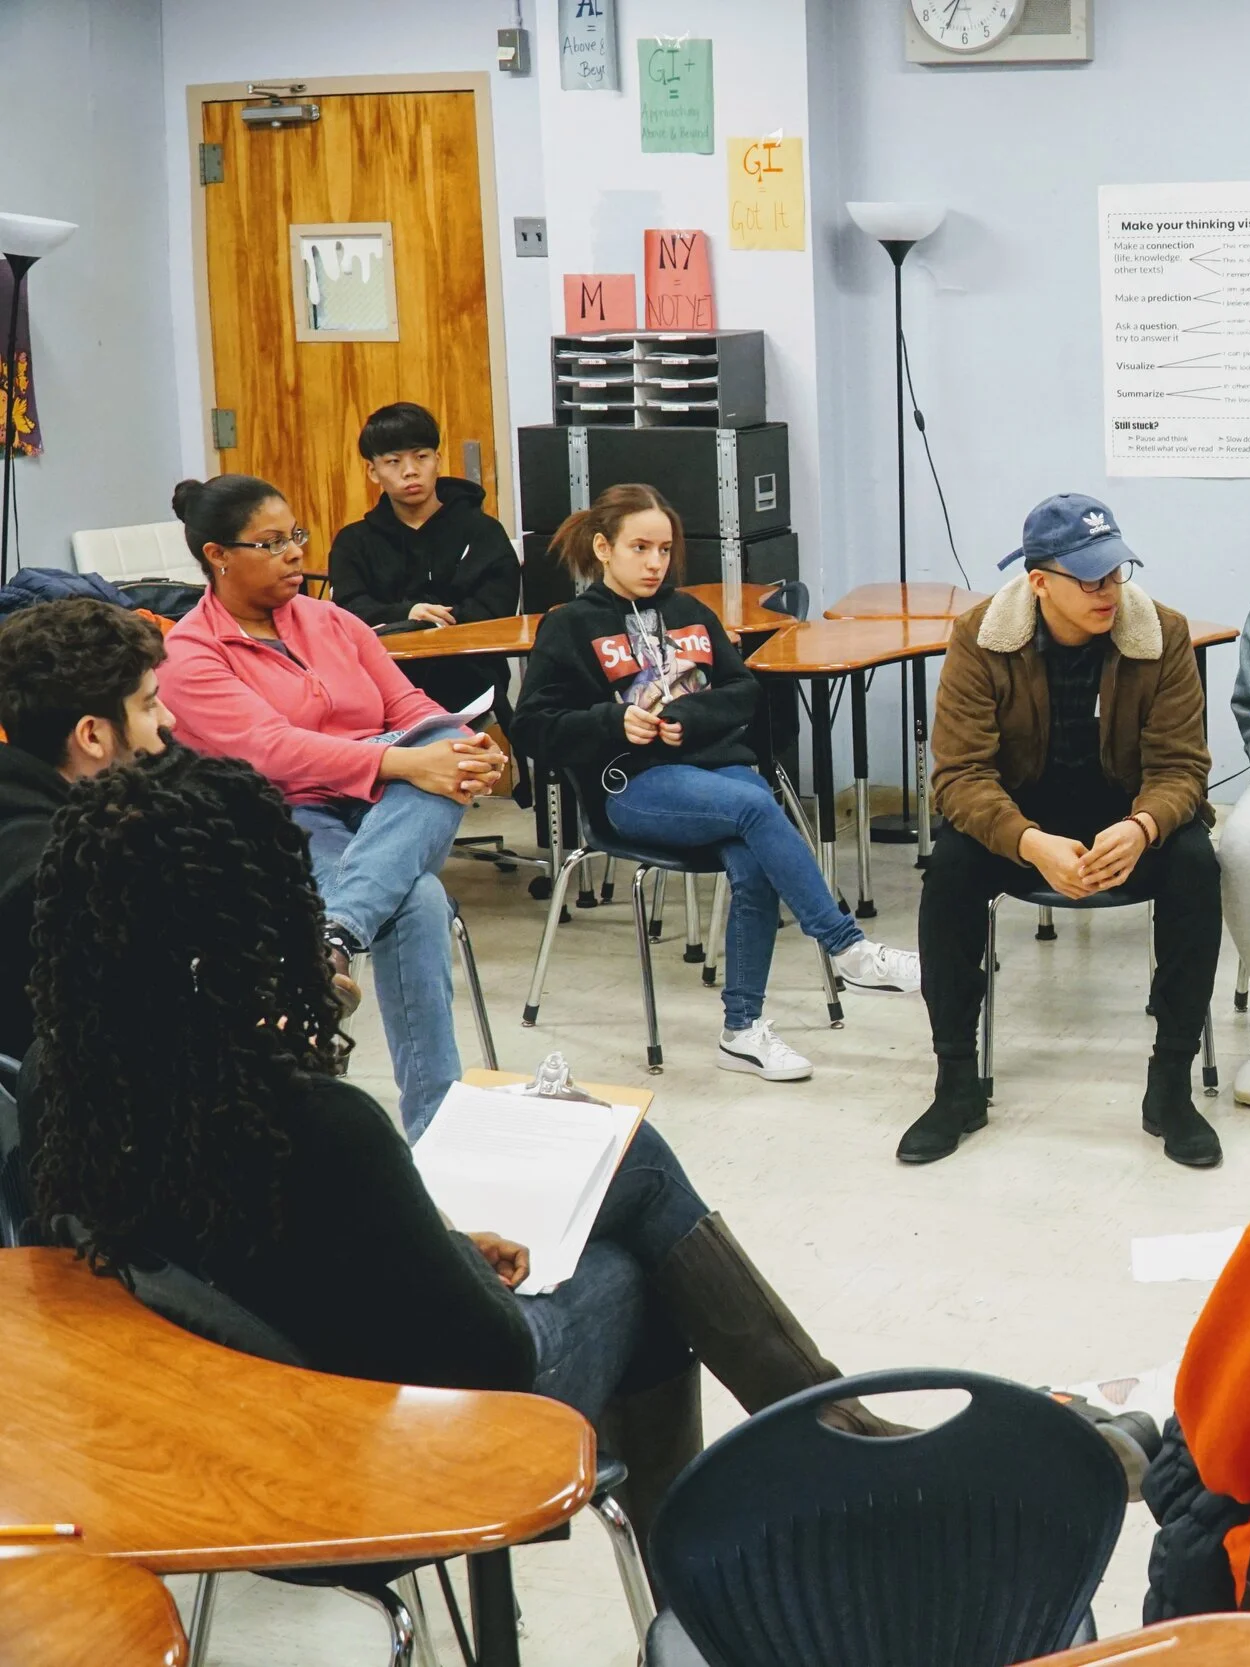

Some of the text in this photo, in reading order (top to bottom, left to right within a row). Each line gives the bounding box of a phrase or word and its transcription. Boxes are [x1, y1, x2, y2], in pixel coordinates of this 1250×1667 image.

[923, 9, 929, 22] 8
[1000, 8, 1007, 18] 4
[939, 27, 945, 39] 7
[961, 32, 968, 44] 6
[983, 26, 990, 38] 5
[563, 37, 596, 55] Above
[743, 142, 783, 182] GI
[731, 201, 790, 240] Got It
[1121, 221, 1154, 231] Make
[1156, 221, 1183, 233] your
[1186, 220, 1235, 231] thinking
[1114, 242, 1138, 250] Make
[1146, 241, 1194, 250] connection
[659, 234, 696, 270] NY
[1140, 266, 1164, 274] texts)
[580, 281, 605, 321] M
[1116, 294, 1139, 302] Make
[1148, 294, 1192, 303] prediction
[646, 294, 680, 327] NOT
[1116, 335, 1127, 343] try
[1173, 334, 1179, 342] it
[1116, 362, 1155, 370] Visualize
[1117, 390, 1164, 398] Summarize
[1115, 421, 1159, 430] Still stuck?
